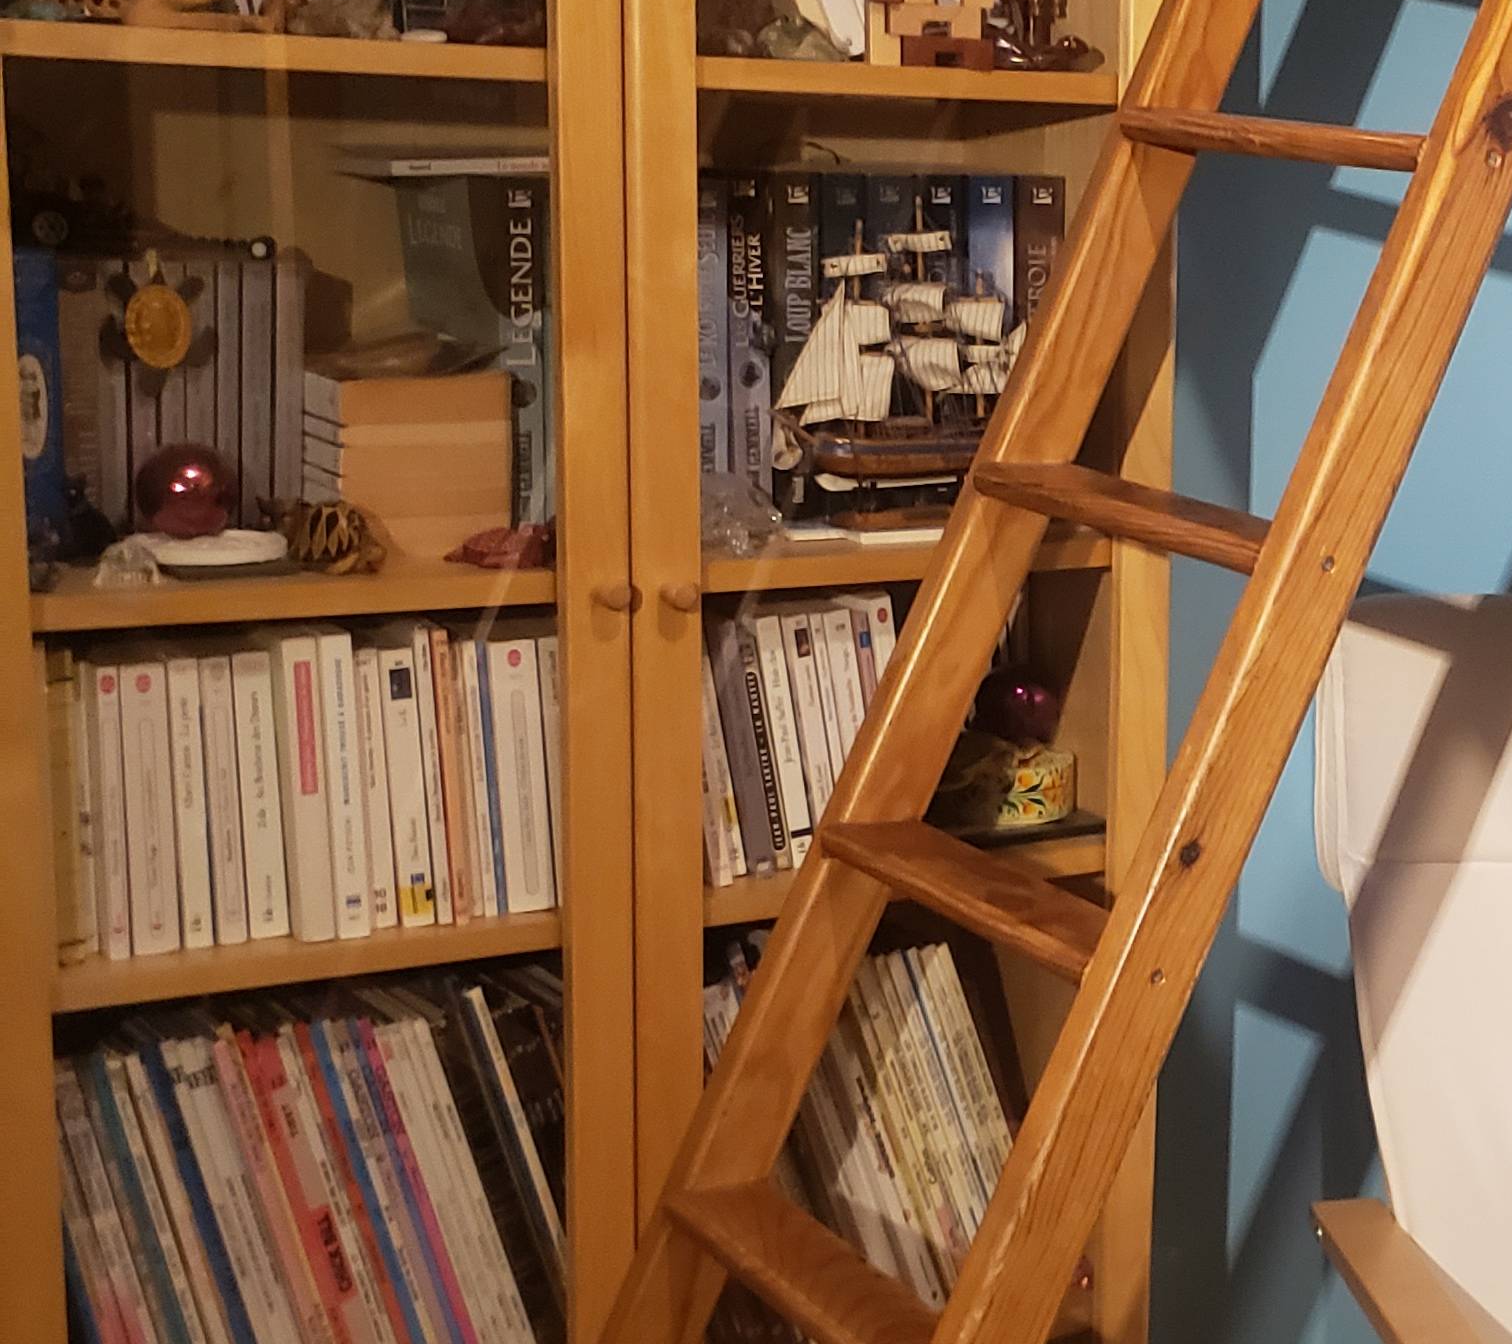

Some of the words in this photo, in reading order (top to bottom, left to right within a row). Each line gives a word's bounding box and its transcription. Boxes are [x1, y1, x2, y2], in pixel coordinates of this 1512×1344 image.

[732, 215, 749, 318] GUERRIERS
[748, 233, 764, 306] L'HIVER
[785, 227, 811, 288] BLANC
[785, 293, 811, 342] LOUP
